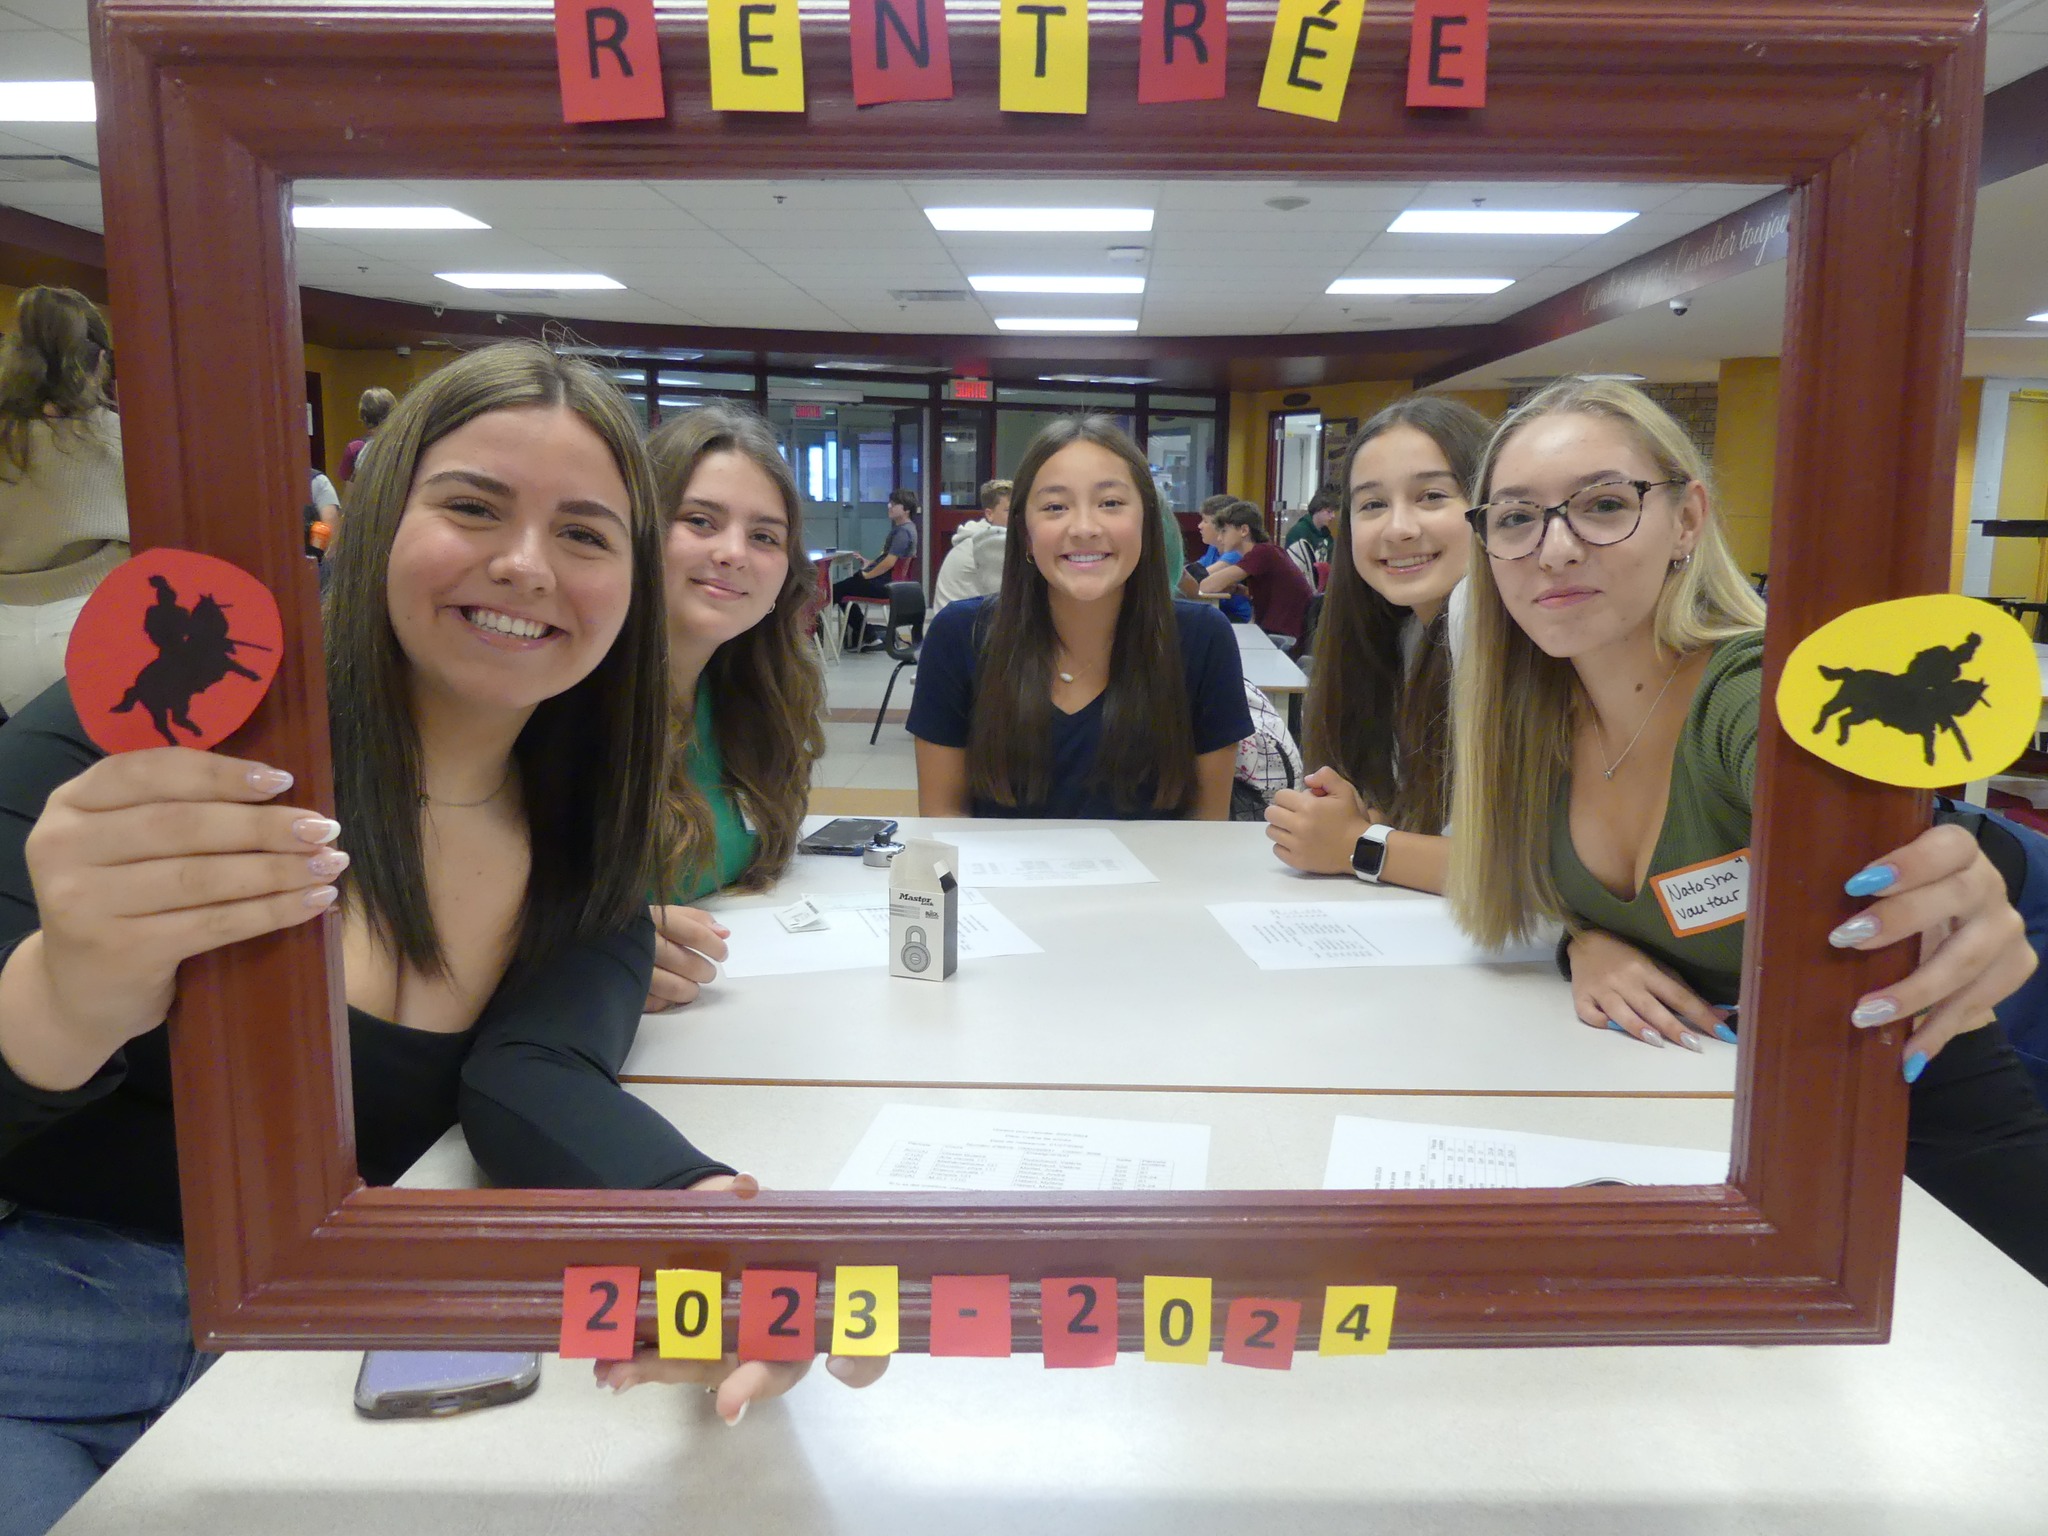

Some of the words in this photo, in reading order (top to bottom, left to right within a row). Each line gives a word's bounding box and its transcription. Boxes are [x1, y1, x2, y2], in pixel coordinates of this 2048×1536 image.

[585, 0, 1468, 91] RENTRÉE
[1673, 224, 1737, 279] Cavalier
[899, 892, 932, 903] Master
[1665, 871, 1738, 902] Natasha
